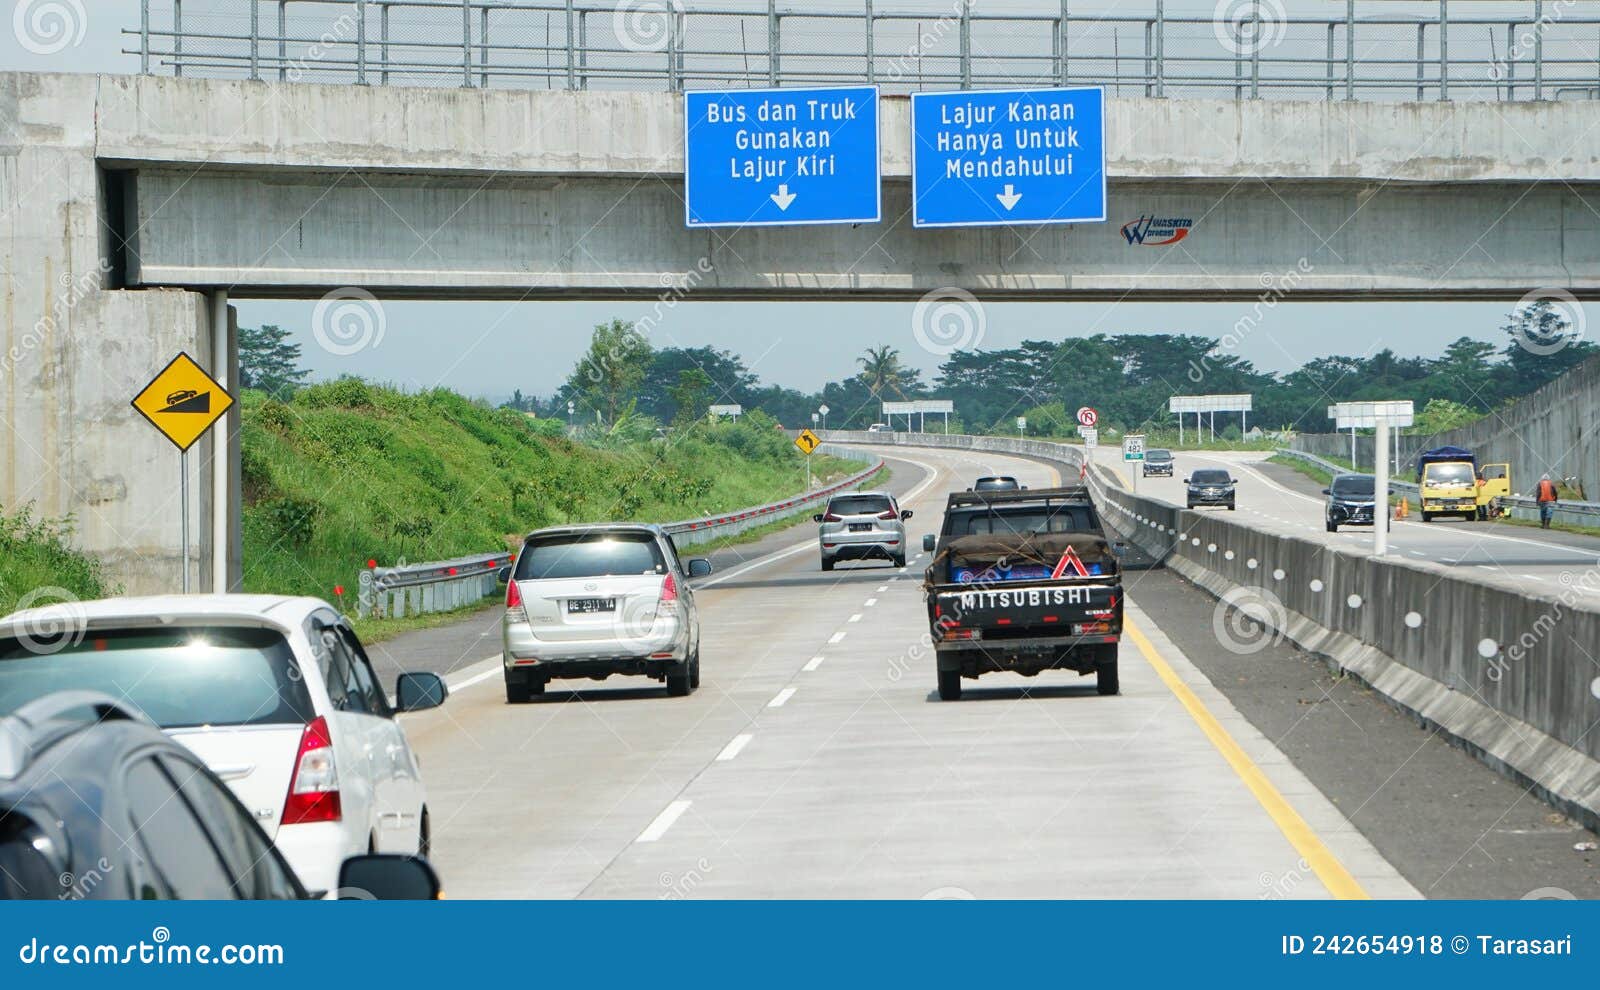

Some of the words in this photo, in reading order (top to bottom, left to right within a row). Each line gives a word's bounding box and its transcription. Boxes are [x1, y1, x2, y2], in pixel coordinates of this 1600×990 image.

[707, 103, 746, 123] Bus
[758, 100, 796, 122] dan
[807, 98, 856, 121] Truk
[941, 102, 996, 129] Lajur
[1008, 102, 1074, 122] Kanan
[735, 127, 830, 149] Gunakan
[937, 131, 1003, 156] Hanya
[1015, 126, 1079, 149] Untuk
[731, 155, 786, 182] Lajur
[797, 154, 835, 177] Kiri
[946, 154, 1073, 178] Mendahului
[1153, 219, 1193, 228] WASKITA
[1127, 445, 1142, 453] 482
[961, 588, 1092, 610] MITSUBISHI
